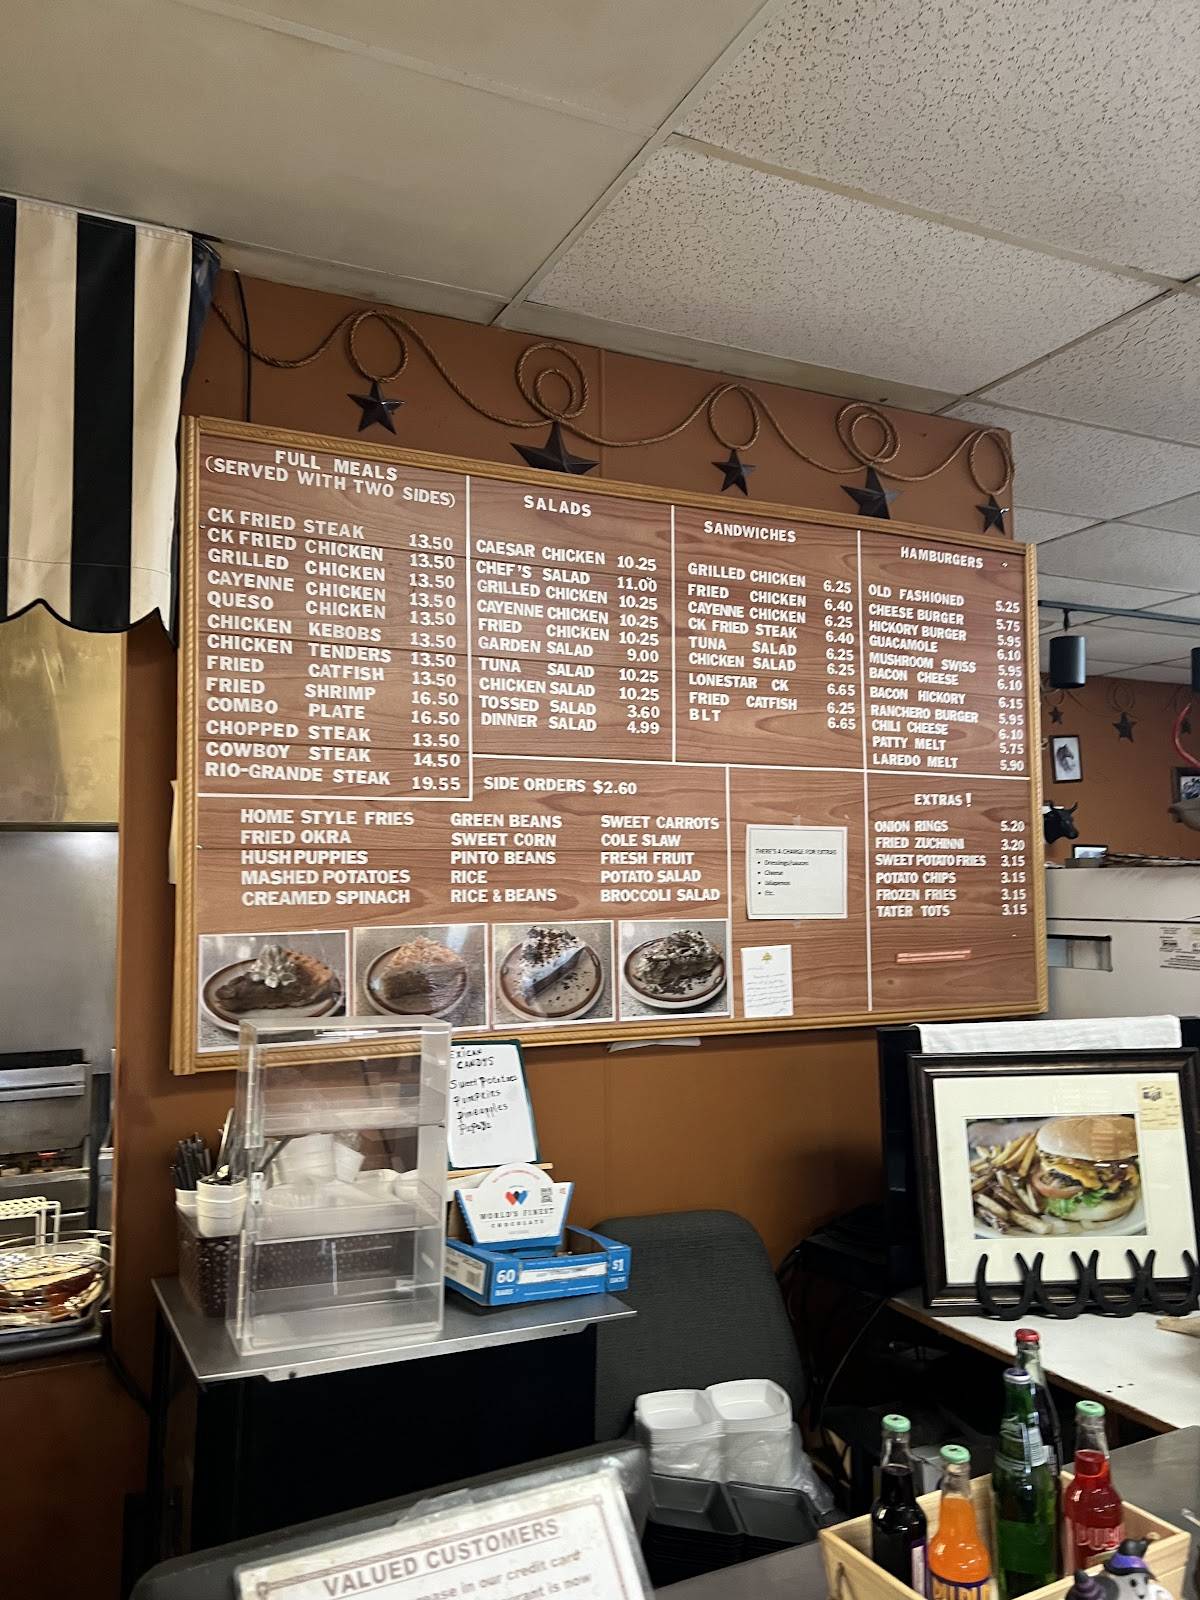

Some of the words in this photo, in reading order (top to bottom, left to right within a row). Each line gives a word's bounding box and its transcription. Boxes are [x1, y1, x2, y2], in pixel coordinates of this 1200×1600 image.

[276, 450, 321, 469] FULL
[334, 459, 398, 481] MEALS
[205, 456, 289, 482] (SERVED
[297, 470, 346, 490] WITH
[354, 479, 394, 497] TWO
[402, 487, 455, 508] SIDES)
[524, 495, 592, 517] SALADS
[208, 507, 234, 524] CK
[240, 511, 296, 530] FRIED
[304, 519, 365, 539] STEAK
[408, 533, 453, 550] 13.50
[704, 521, 796, 543] SANDWICHES
[476, 539, 535, 557] CAESAR
[542, 547, 605, 565] CHICKEN
[617, 556, 656, 571] 10.25
[901, 546, 984, 569] HAMBURGERS
[207, 570, 294, 592] CAYENNE
[306, 582, 385, 602] CHICKEN
[409, 593, 455, 609] 13.50
[688, 563, 745, 580] GRILLED
[750, 570, 806, 587] CHICKEN
[823, 580, 851, 594] 6.25
[477, 580, 540, 597] GRILLED
[546, 586, 607, 604] CHICKEN
[619, 596, 657, 611] 10.25
[688, 584, 729, 598] FRIED
[750, 591, 806, 607] CHICKEN
[824, 599, 853, 612] 6.40
[868, 584, 891, 598] OLD
[900, 589, 964, 607] FASHIONED
[995, 601, 1020, 613] 5.25
[207, 591, 273, 610] QUESO
[305, 600, 385, 619] CHICKEN
[410, 611, 455, 626] 13.50
[869, 604, 914, 619] CHEESE
[917, 609, 964, 625] BURGER
[996, 619, 1020, 632] 5.75
[207, 614, 292, 634] CHICKEN
[308, 622, 381, 641] KEBOBS
[410, 632, 456, 649] 13.50
[478, 618, 522, 634] FRIED
[546, 624, 609, 641] CHICKEN
[619, 632, 659, 646] 10.25
[207, 634, 292, 654] CHICKEN
[308, 643, 391, 663] TENDERS
[411, 652, 456, 667] 13.50
[478, 636, 540, 653] GARDEN
[546, 641, 593, 657] SALAD
[627, 649, 659, 662] 9.00
[688, 636, 726, 650] TUNA
[752, 641, 796, 656] SALAD
[826, 648, 854, 661] 6.25
[869, 635, 938, 653] GUACAMOLE
[997, 650, 1021, 661] 6.10
[207, 656, 264, 672] FRIED
[308, 664, 384, 680] CATFISH
[411, 671, 456, 687] 13.50
[479, 658, 521, 673] TUNA
[547, 663, 594, 678] SALAD
[619, 668, 659, 683] 10.25
[689, 673, 757, 689] LONESTAR
[772, 679, 789, 692] CK
[827, 683, 855, 696] 6.65
[479, 695, 539, 711] TOSSED
[550, 700, 596, 715] SALAD
[627, 705, 660, 719] 3.60
[689, 692, 729, 706] FRIED
[746, 696, 797, 710] CATFISH
[827, 702, 855, 714] 6.25
[870, 687, 908, 700] BACON
[918, 690, 965, 705] HICKORY
[998, 697, 1023, 709] 6.15
[206, 697, 278, 714] COMBO
[308, 704, 365, 720] PLATE
[411, 711, 460, 726] 16.50
[206, 742, 290, 759] COWBOY
[308, 746, 371, 762] STEAK
[413, 752, 461, 768] 14.50
[873, 736, 908, 748] PATTY
[915, 738, 946, 751] MELT
[1000, 744, 1024, 754] 5.75
[873, 753, 921, 766] LAREDO
[927, 756, 958, 768] MELT
[1000, 760, 1024, 771] 5.90
[205, 762, 322, 782] RIO-GRANDE
[333, 769, 390, 785] STEAK
[412, 776, 461, 790] 19.55
[484, 777, 519, 790] SIDE
[524, 777, 586, 793] ORDERS
[593, 780, 636, 795] $2.60
[241, 809, 294, 824] HOME
[301, 811, 357, 824] STYLE
[365, 812, 414, 825] FRIES
[450, 813, 504, 827] GREEN
[509, 815, 562, 829] BEANS
[601, 815, 649, 829] SWEET
[656, 816, 719, 829] CARROTS
[875, 821, 910, 832] ONION
[915, 821, 948, 832] RINGS
[1001, 821, 1024, 832] 5.20
[241, 830, 295, 844] FRIED
[300, 830, 352, 844] OKRA
[451, 833, 507, 846] SWEET
[514, 834, 556, 847] CORN
[601, 834, 637, 847] COLE
[642, 834, 681, 846] SLAW
[451, 851, 499, 864] PINTO
[504, 852, 556, 865] BEANS
[601, 852, 647, 864] FRESH
[653, 852, 695, 865] FRUIT
[241, 870, 318, 885] MASHED
[323, 870, 411, 883] POTATOES
[451, 871, 488, 884] RICE
[601, 870, 654, 883] POTATO
[657, 870, 701, 882] SALAD
[876, 872, 918, 884] POTATO
[923, 872, 956, 884] CHIPS
[1001, 872, 1026, 883] 3.15
[242, 891, 331, 906] CREAMED
[336, 890, 410, 904] SPINACH
[451, 890, 488, 902] RICE
[493, 890, 501, 901] &
[505, 889, 556, 902] BEANS
[601, 889, 672, 902] BROCCOLI
[677, 889, 720, 901] SALAD
[877, 906, 913, 917] TATER
[921, 905, 950, 916] TOTS
[1002, 904, 1027, 915] 3.15
[480, 1211, 518, 1219] WORLD'S
[523, 1208, 554, 1216] FINEST
[496, 1270, 516, 1283] 60
[323, 1557, 418, 1597] VALUED
[426, 1518, 560, 1569] CUSTOMERS
[506, 1560, 546, 1580] credit
